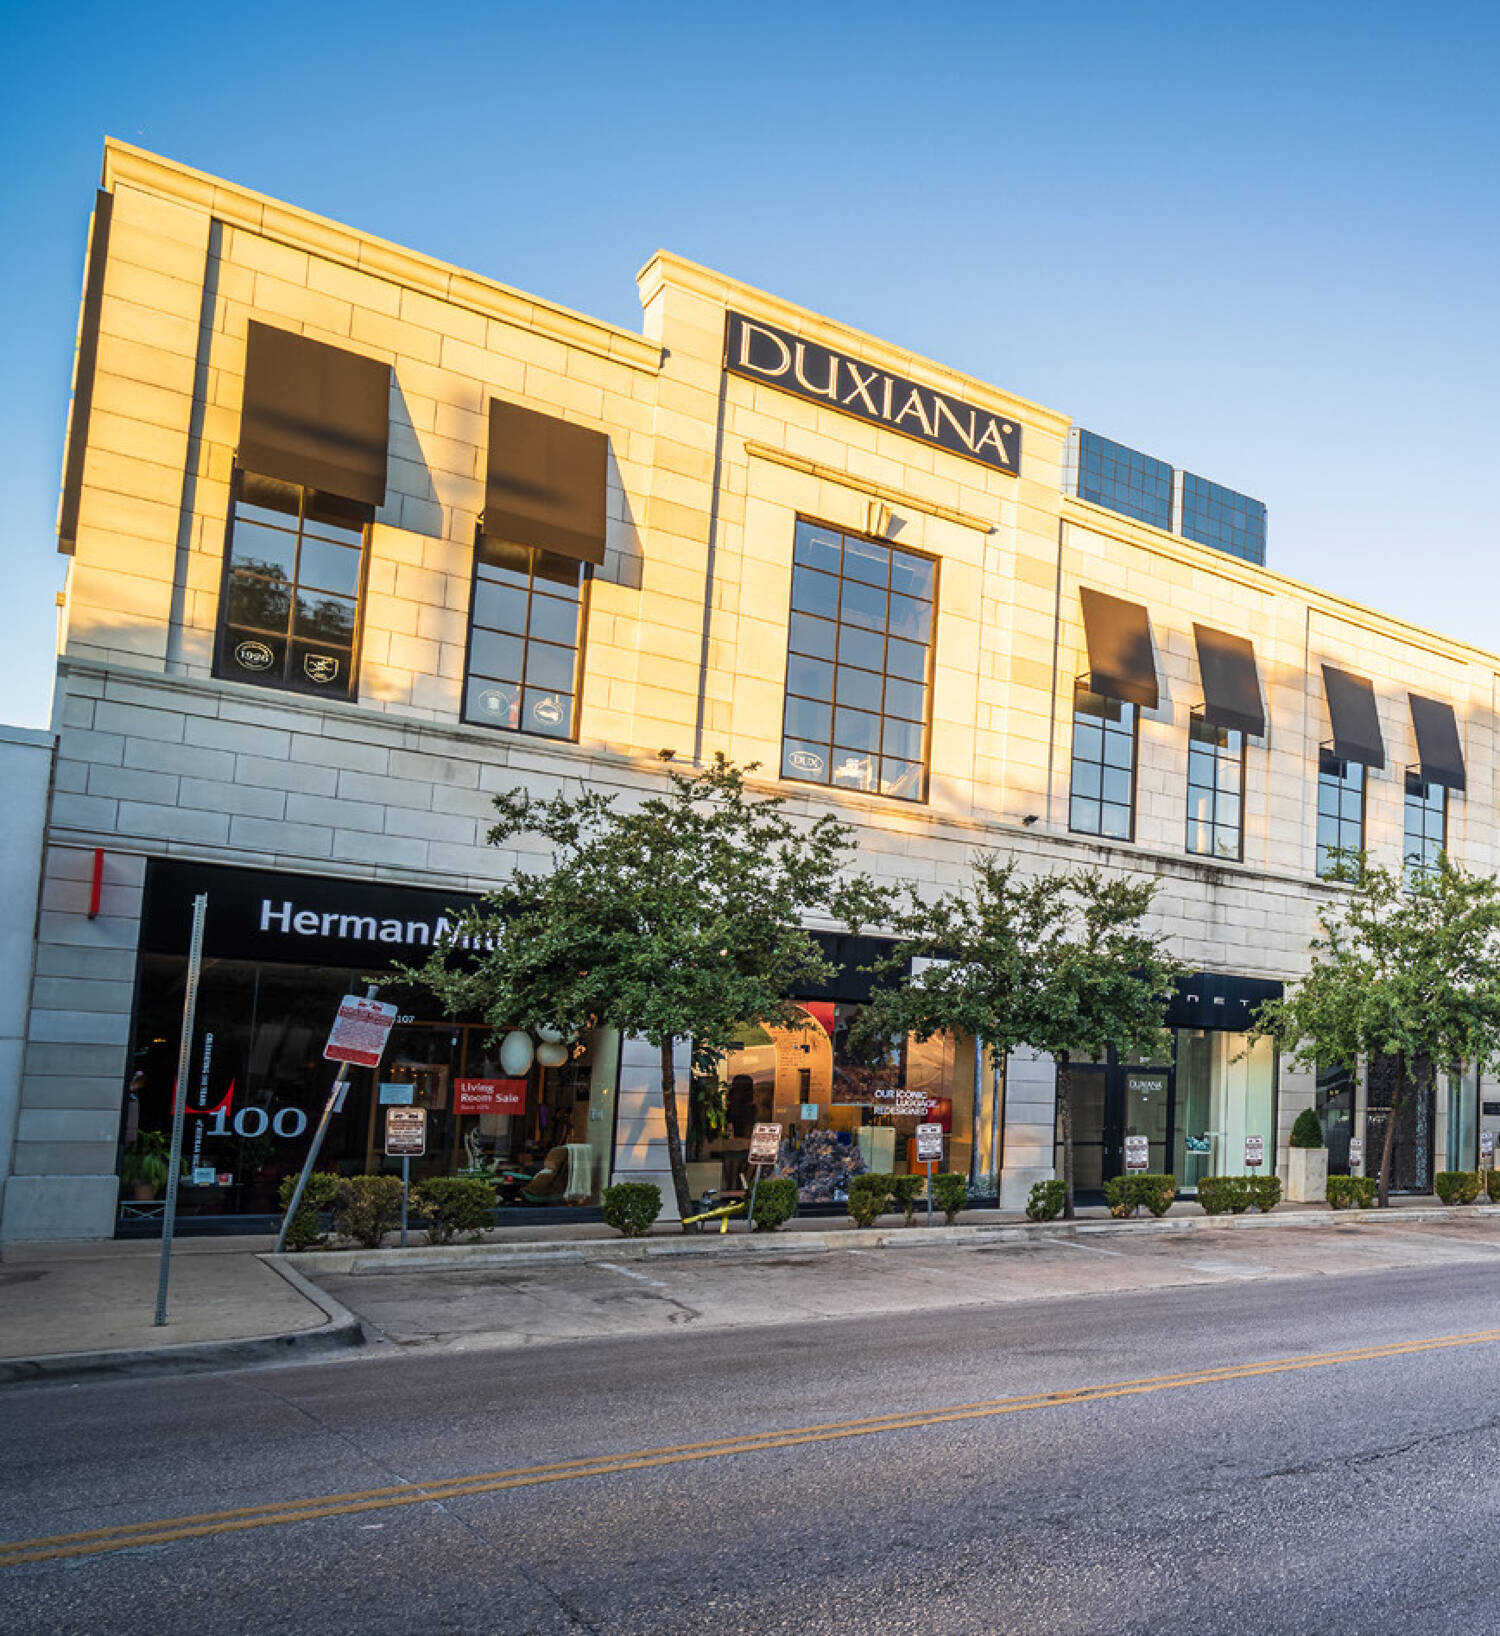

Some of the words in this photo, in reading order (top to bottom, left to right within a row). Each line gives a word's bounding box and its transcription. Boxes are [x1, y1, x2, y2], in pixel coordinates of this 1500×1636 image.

[738, 320, 1010, 464] DUXIANA
[460, 1082, 495, 1095] Living
[874, 1089, 895, 1098] OUR
[895, 1089, 928, 1100] ICONIC
[460, 1093, 493, 1103] Room
[495, 1094, 519, 1103] Sale
[206, 1104, 308, 1138] 100
